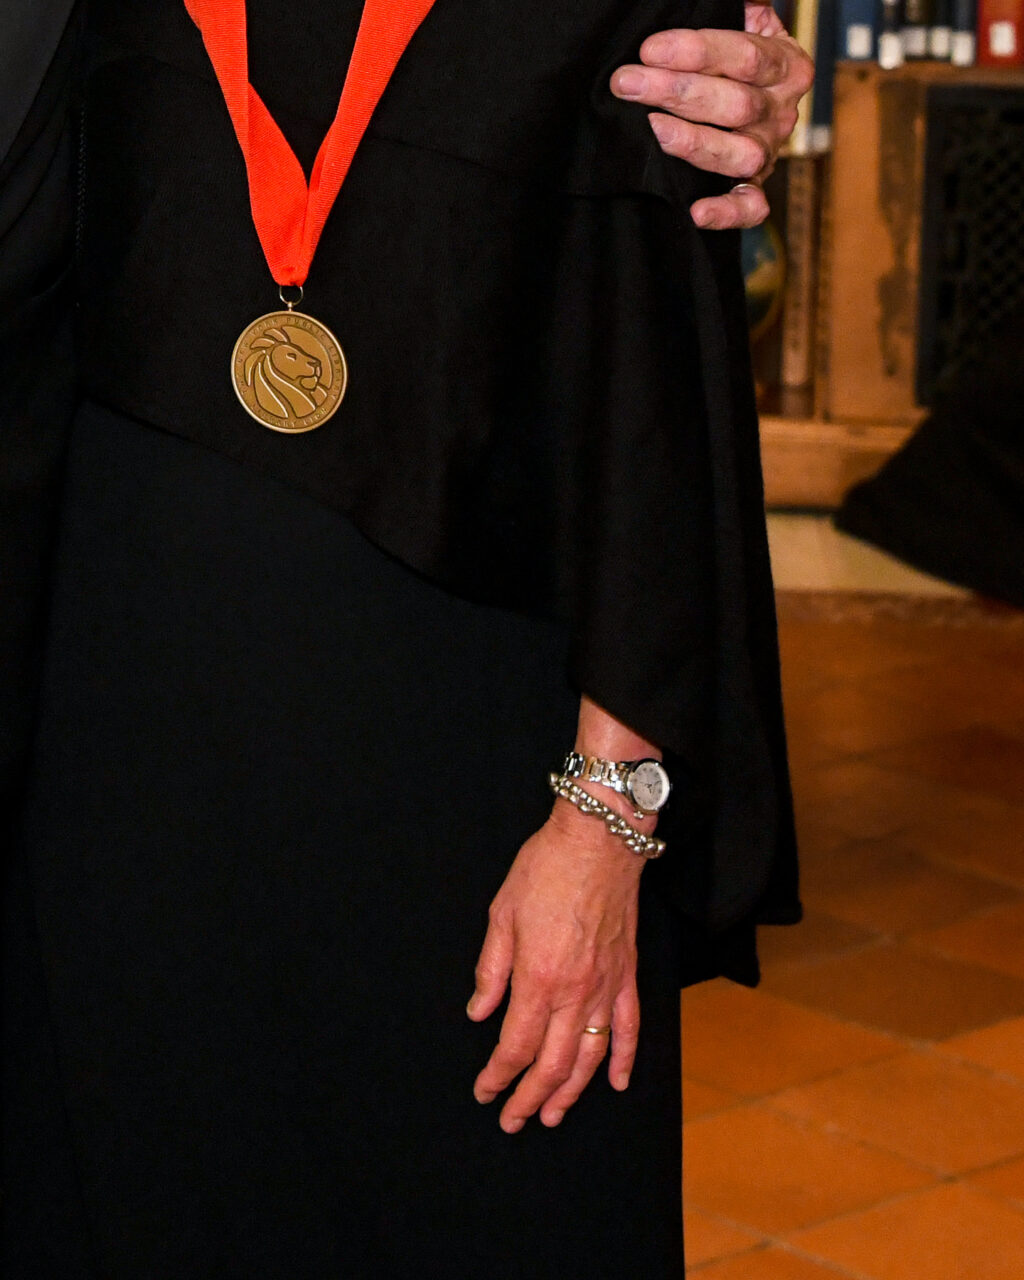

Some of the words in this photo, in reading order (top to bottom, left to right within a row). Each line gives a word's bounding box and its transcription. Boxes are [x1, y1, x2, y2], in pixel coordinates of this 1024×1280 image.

[251, 318, 278, 337] YORK
[286, 316, 327, 340] PUBLIC
[327, 344, 342, 401] LIBRARY
